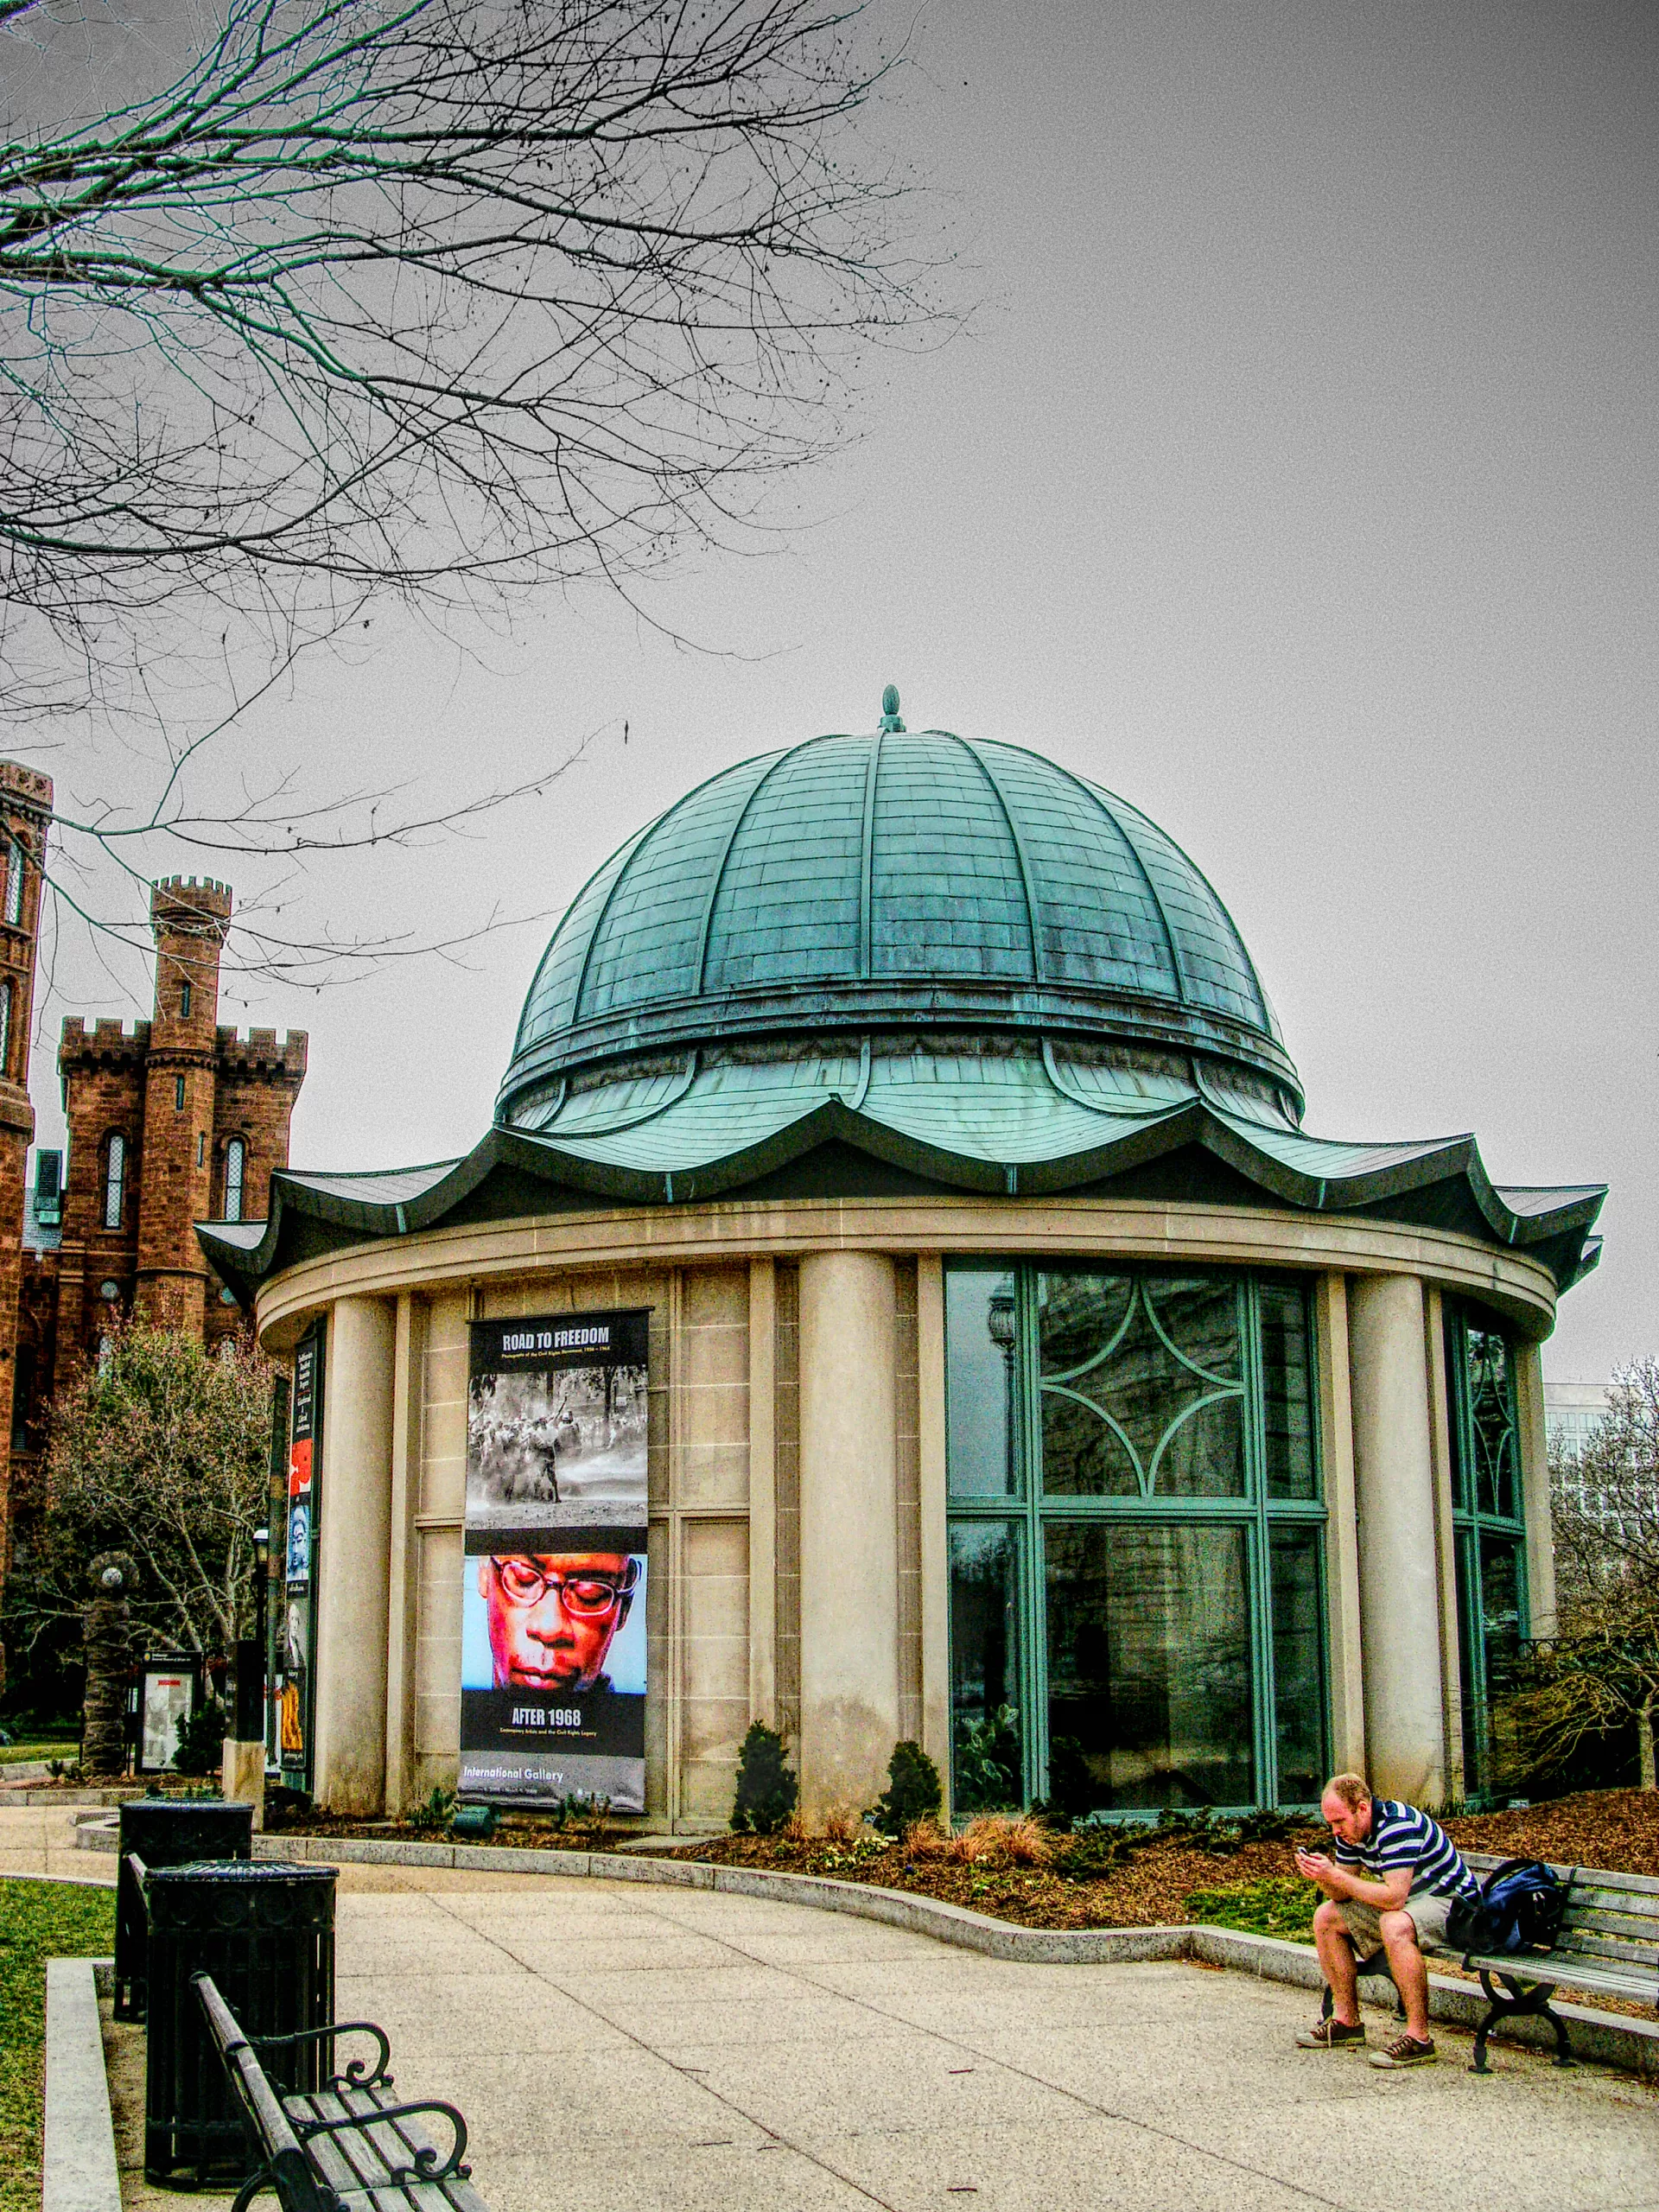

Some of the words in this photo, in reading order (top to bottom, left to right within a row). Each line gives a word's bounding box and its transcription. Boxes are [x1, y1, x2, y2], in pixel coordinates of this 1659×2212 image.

[503, 1333, 535, 1351] ROAD
[537, 1332, 552, 1350] TO
[554, 1326, 610, 1348] FREEDOM
[512, 1707, 545, 1726] AFTER
[548, 1708, 582, 1726] 1968
[463, 1765, 522, 1780] International
[524, 1767, 564, 1783] Gallery
